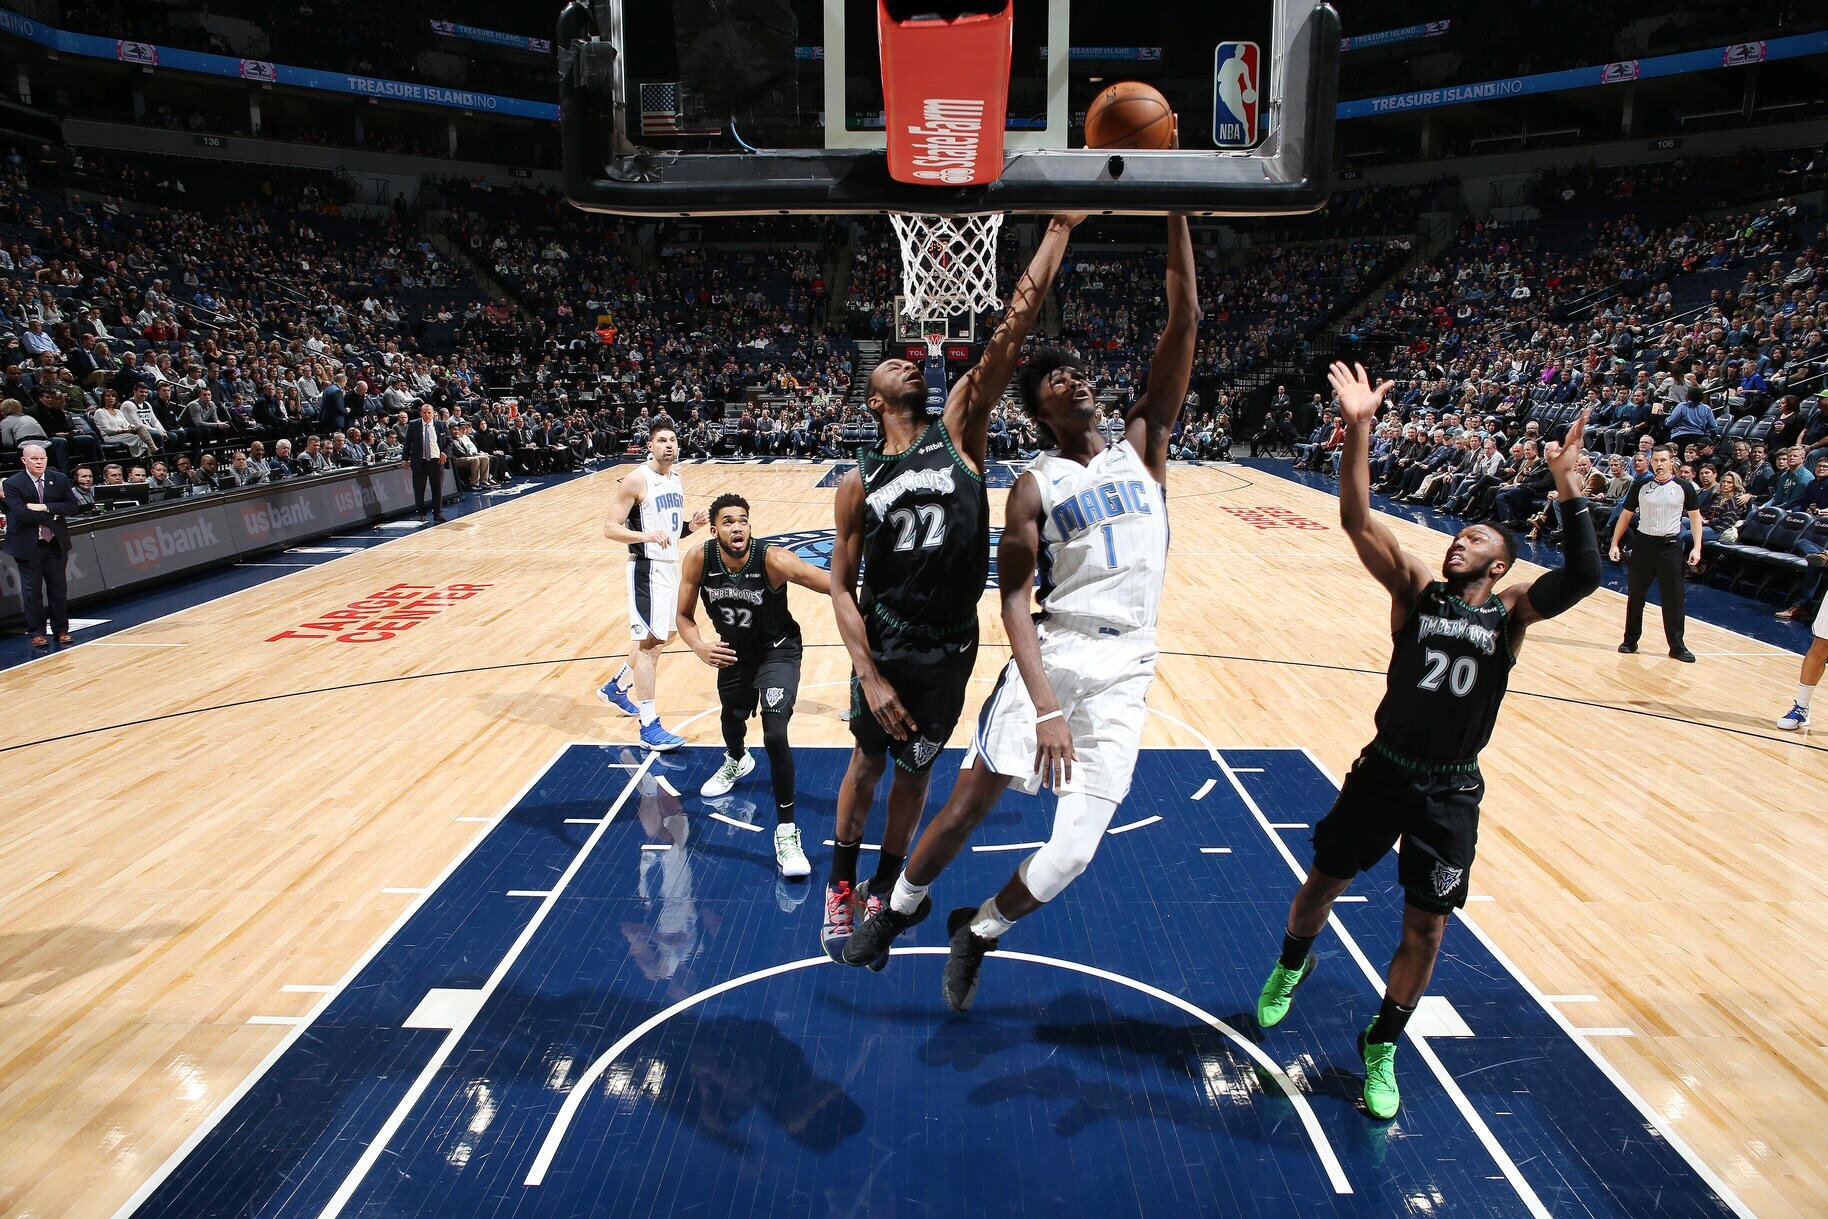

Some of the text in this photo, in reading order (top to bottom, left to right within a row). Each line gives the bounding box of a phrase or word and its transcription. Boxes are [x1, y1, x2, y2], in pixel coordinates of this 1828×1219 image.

[347, 77, 421, 99] TREASURE
[1372, 91, 1441, 112] TREASURE
[203, 137, 220, 147] 136
[1219, 123, 1241, 140] NBA
[1657, 138, 1674, 149] 106
[925, 441, 944, 453] fitbit
[865, 463, 956, 523] TIMBERWOLVES
[671, 512, 679, 531] 9
[1051, 480, 1152, 541] MAGIC
[888, 503, 946, 552] 22
[1100, 523, 1118, 569] 1
[704, 585, 765, 606] TIMBERWOLVES
[263, 583, 436, 643] TARGET
[336, 583, 494, 643] CENTER
[718, 605, 753, 629] 32
[1417, 614, 1499, 656] TIMBERWOLVES
[1416, 646, 1479, 698] 20
